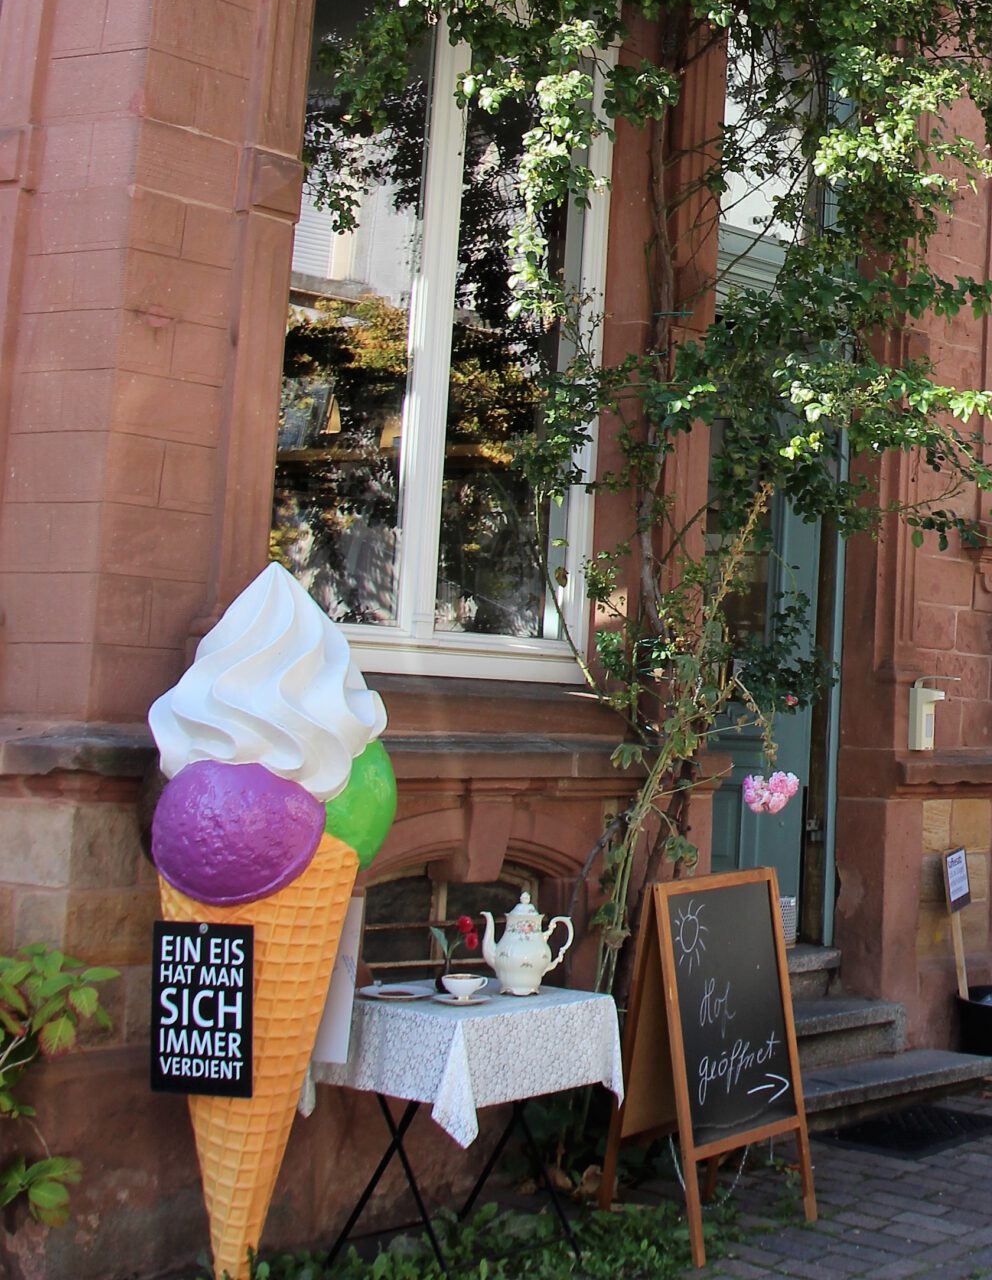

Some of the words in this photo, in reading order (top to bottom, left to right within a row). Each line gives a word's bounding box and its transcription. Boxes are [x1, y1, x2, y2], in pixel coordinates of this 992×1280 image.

[161, 935, 201, 963] EIN
[209, 937, 245, 966] EIS
[160, 963, 195, 985] HAT
[199, 966, 244, 988] MAN
[160, 987, 243, 1030] SICH
[699, 977, 737, 1039] Hof
[159, 1028, 242, 1058] IMMER
[159, 1056, 244, 1081] VERDIENT
